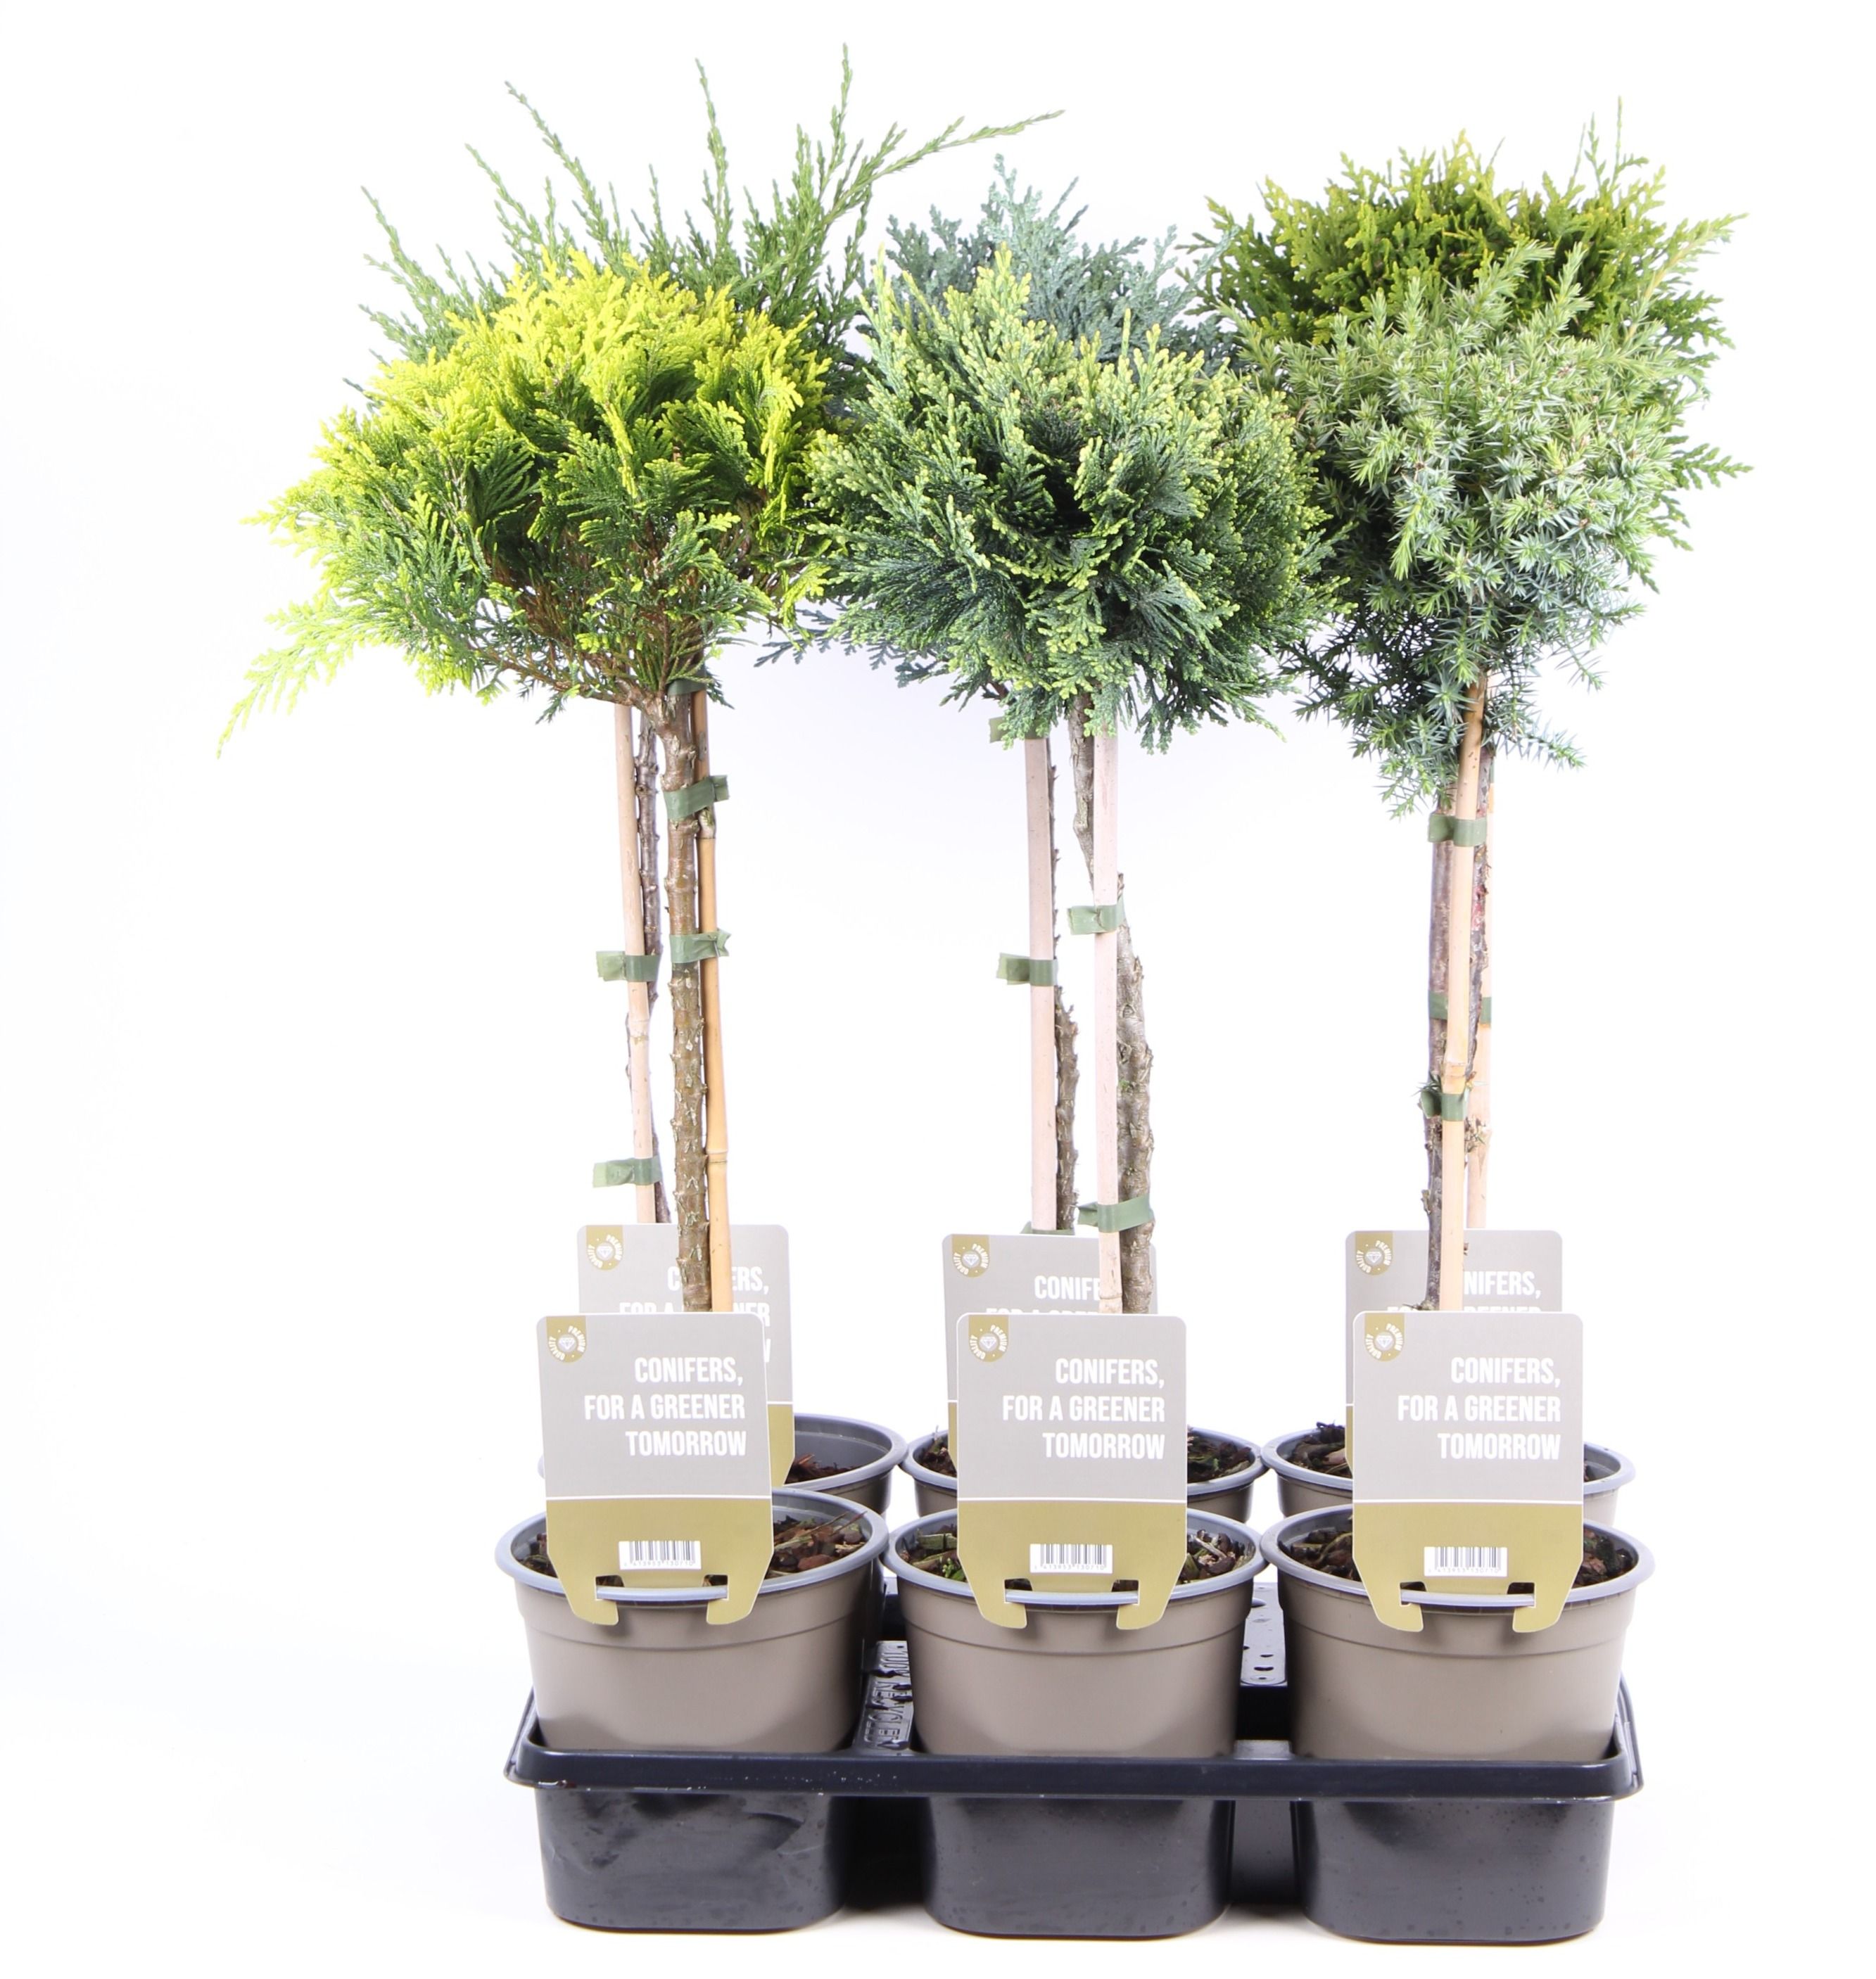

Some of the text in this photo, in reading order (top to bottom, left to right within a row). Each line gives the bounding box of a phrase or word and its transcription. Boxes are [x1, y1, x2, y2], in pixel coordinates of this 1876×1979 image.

[1464, 1271, 1541, 1299] NIFERS,
[635, 1356, 743, 1386] CONIFERS,
[1056, 1358, 1165, 1389] CONIFERS,
[1451, 1357, 1561, 1388] CONIFERS,
[584, 1394, 745, 1420] FOR A GREENER
[1003, 1395, 1165, 1422] FOR A GREENER
[1398, 1394, 1561, 1422] FOR A GREENER
[625, 1430, 747, 1456] TOMORROW
[1042, 1432, 1165, 1459] TOMORROW
[1437, 1432, 1561, 1460] TOMORROW
